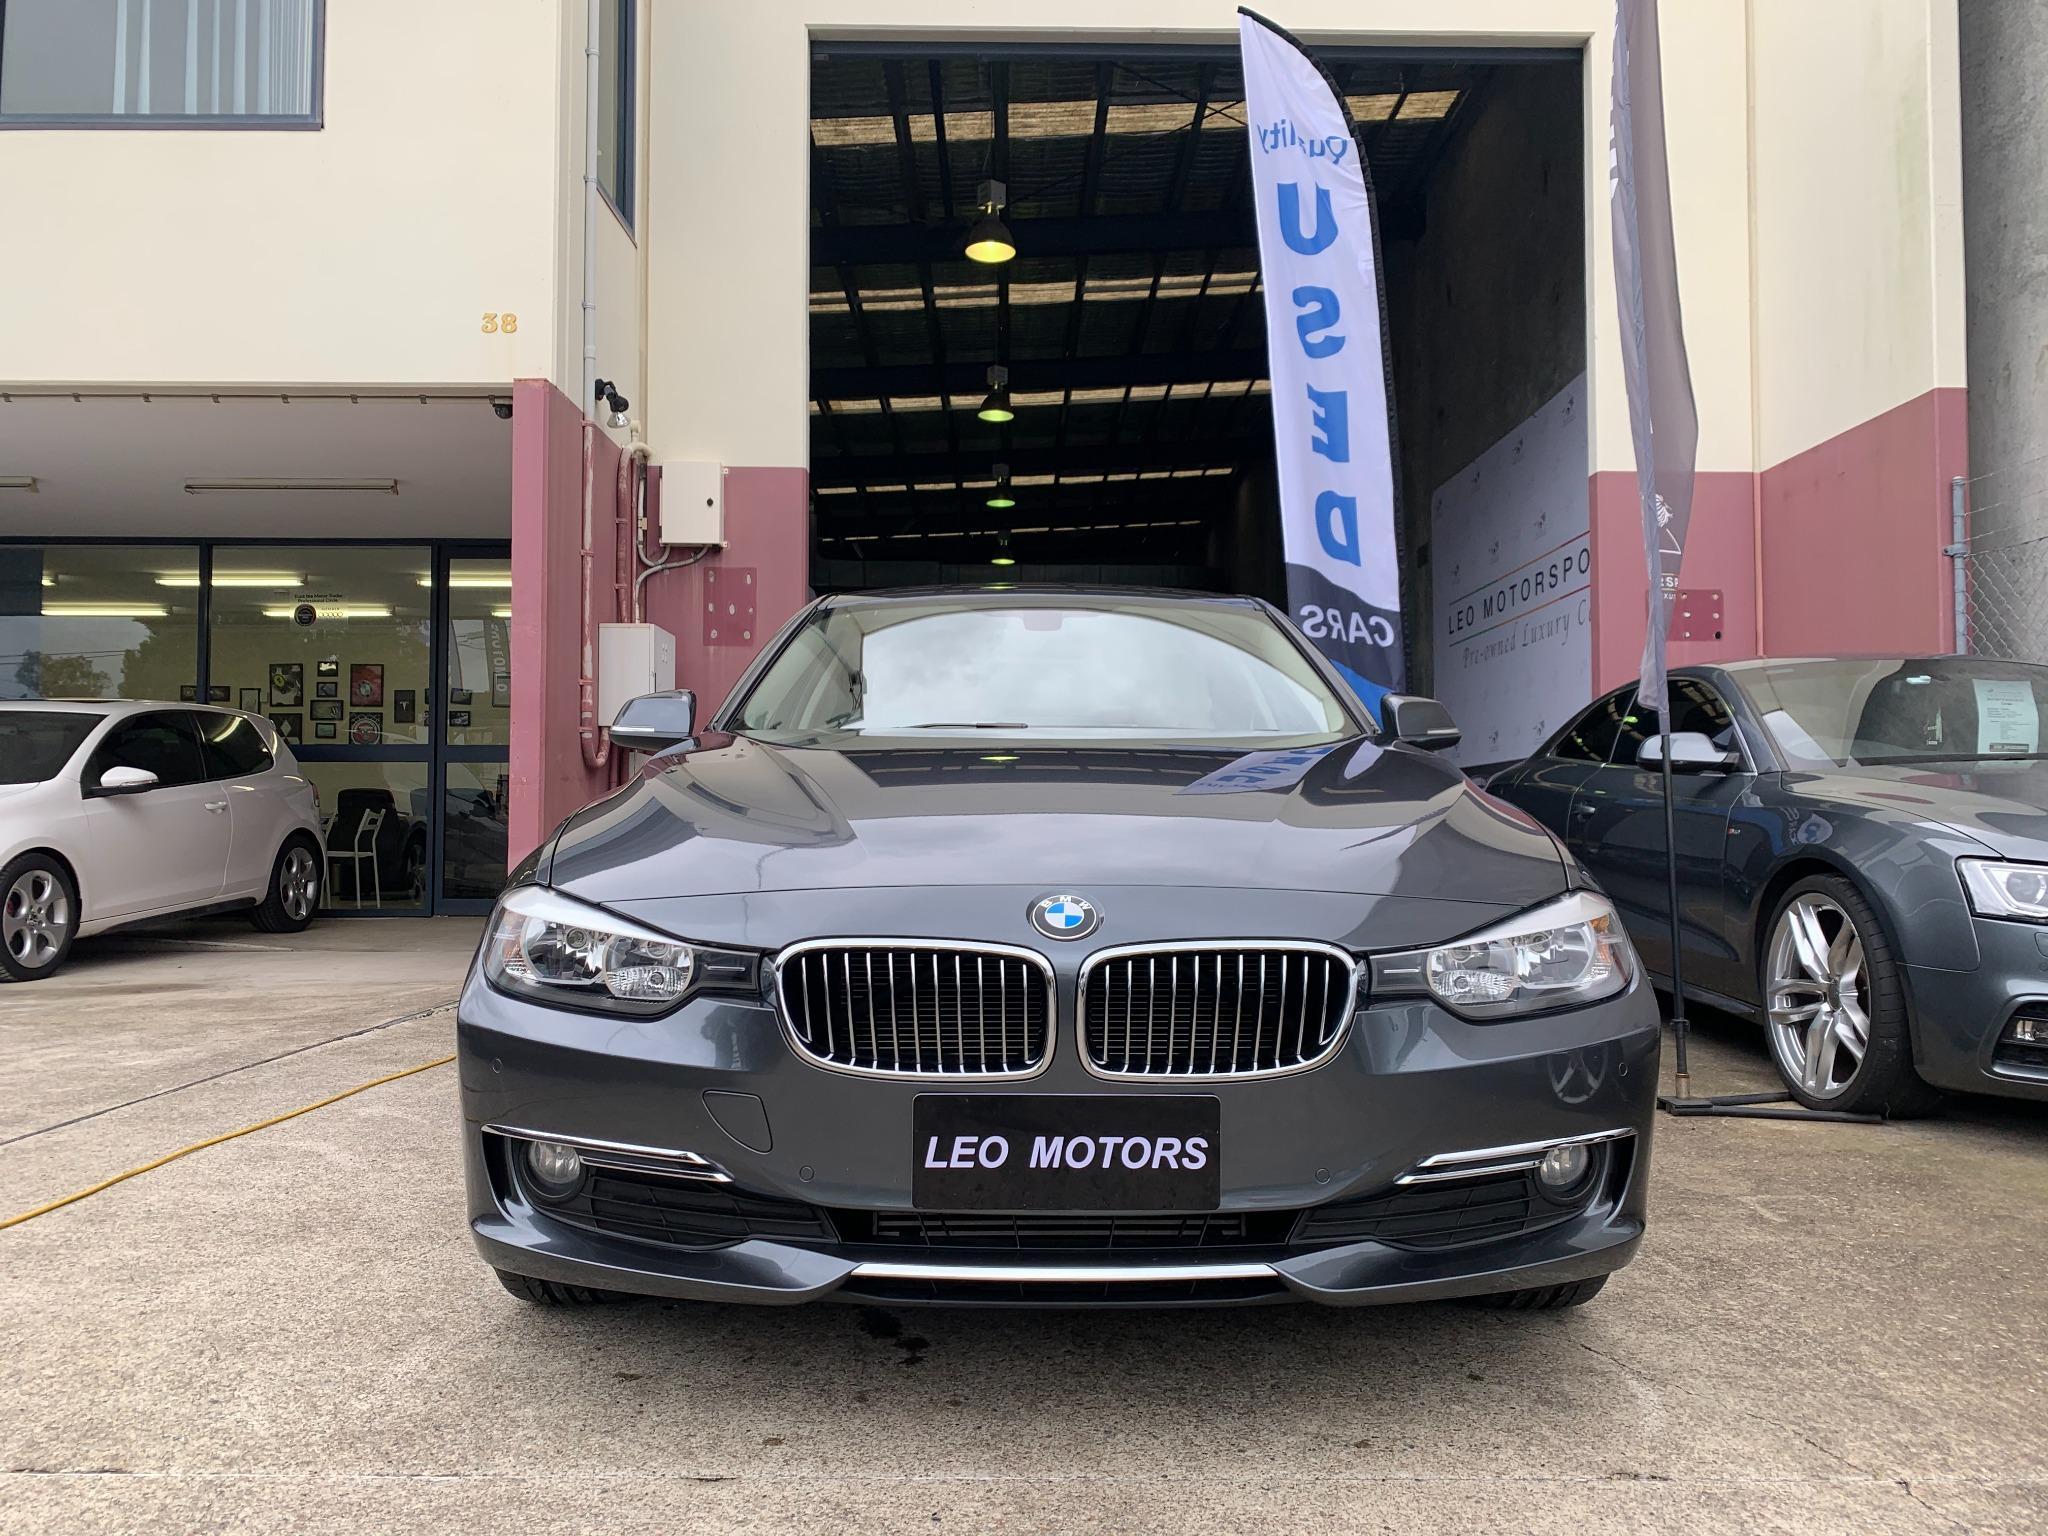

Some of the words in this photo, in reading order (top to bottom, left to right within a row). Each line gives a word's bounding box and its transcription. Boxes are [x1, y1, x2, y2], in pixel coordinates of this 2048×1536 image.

[480, 312, 518, 333] 38
[1448, 605, 1475, 635] LEO
[1483, 547, 1591, 619] MOTORSPO
[1521, 612, 1571, 647] Luxury
[1039, 895, 1093, 910] BMW
[923, 1135, 1010, 1169] LEO
[1028, 1135, 1210, 1170] MOTORS
